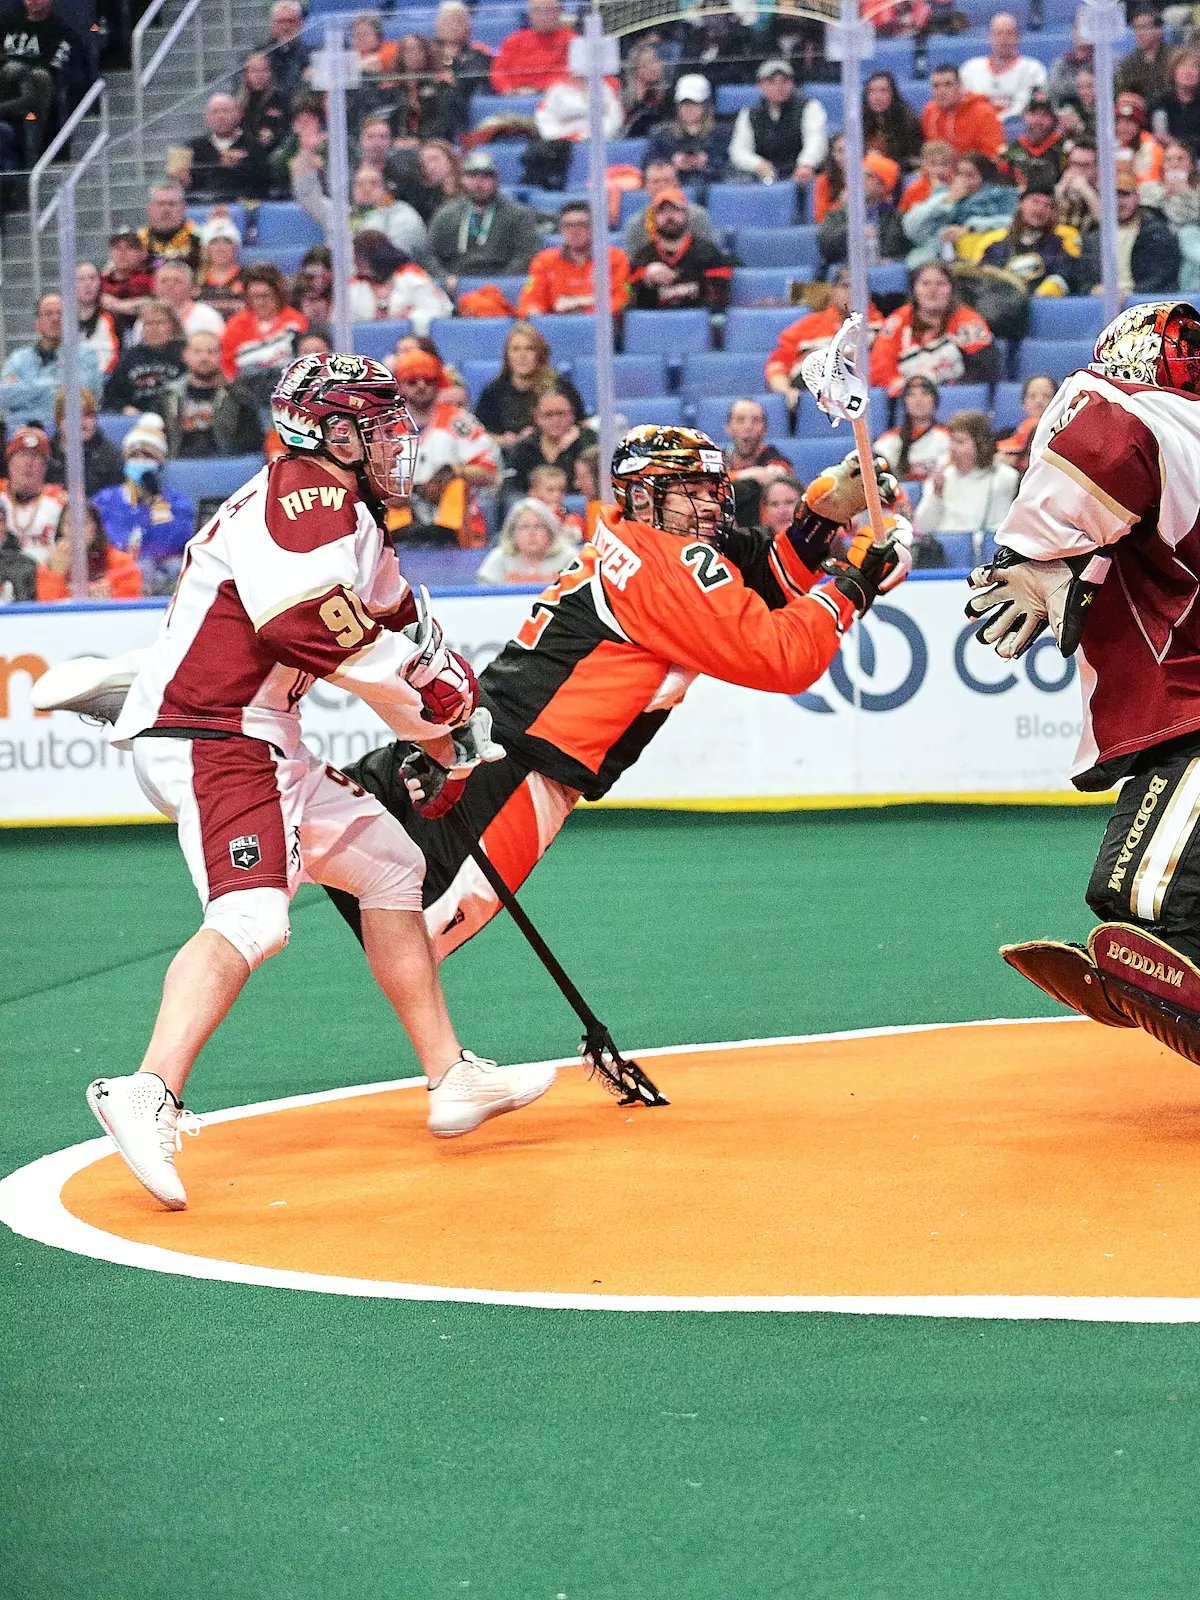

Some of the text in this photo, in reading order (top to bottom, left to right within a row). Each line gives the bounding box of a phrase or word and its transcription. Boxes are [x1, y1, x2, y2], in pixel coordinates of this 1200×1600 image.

[277, 486, 348, 521] AFW
[680, 541, 734, 594] 2
[1107, 774, 1169, 893] BODDAM
[1106, 940, 1185, 989] BODDAM
